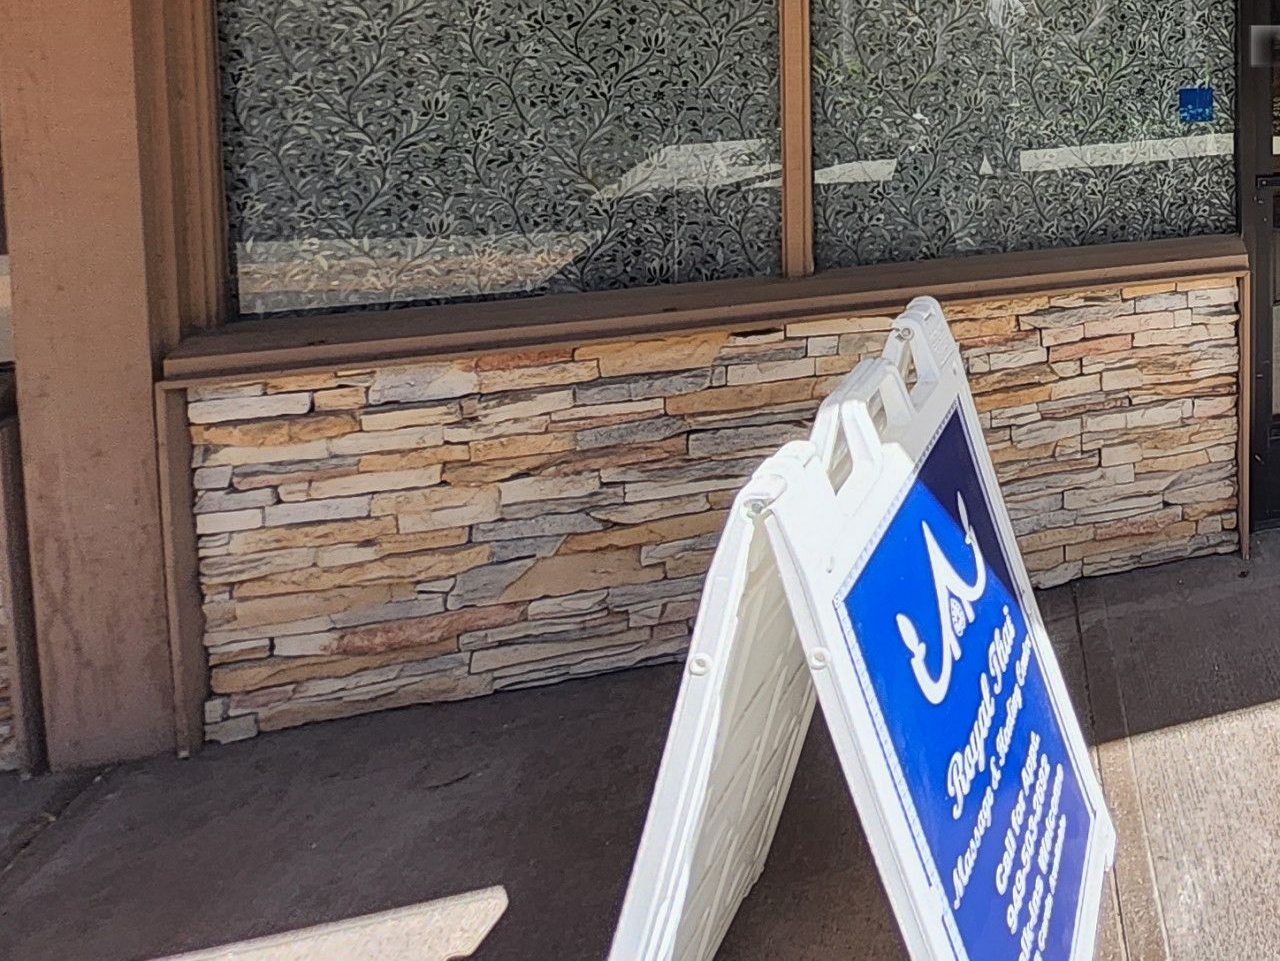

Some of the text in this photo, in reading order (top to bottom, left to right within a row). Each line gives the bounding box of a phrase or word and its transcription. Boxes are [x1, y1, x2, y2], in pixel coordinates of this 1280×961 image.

[947, 605, 1015, 820] Royal Thai
[953, 786, 994, 910] Massage
[996, 828, 1017, 896] Call
[1011, 789, 1026, 836] for
[1007, 753, 1050, 935] 949-503-2692
